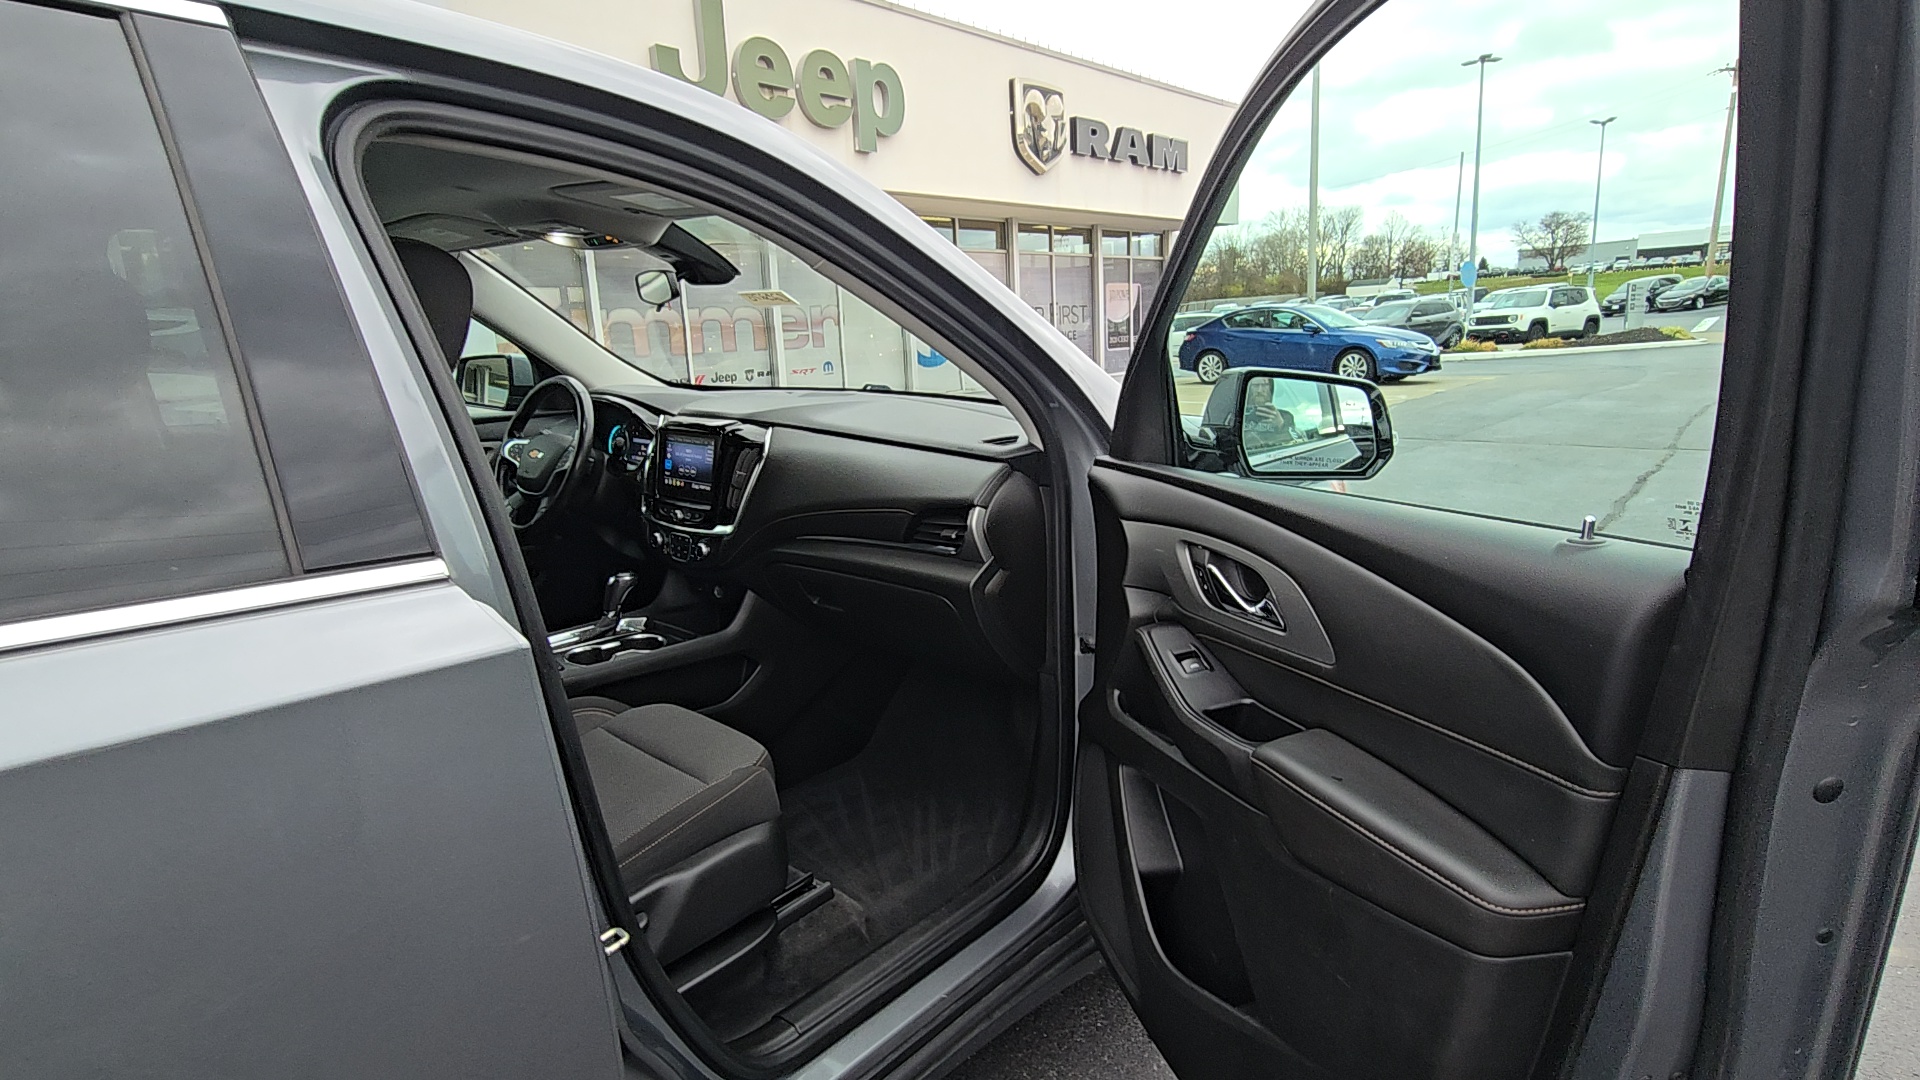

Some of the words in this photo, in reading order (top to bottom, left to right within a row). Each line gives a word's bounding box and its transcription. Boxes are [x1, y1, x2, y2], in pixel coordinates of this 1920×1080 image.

[649, 0, 905, 153] Jeep
[1069, 116, 1189, 174] RAM
[711, 372, 738, 384] Jeep
[790, 367, 817, 376] SRT
